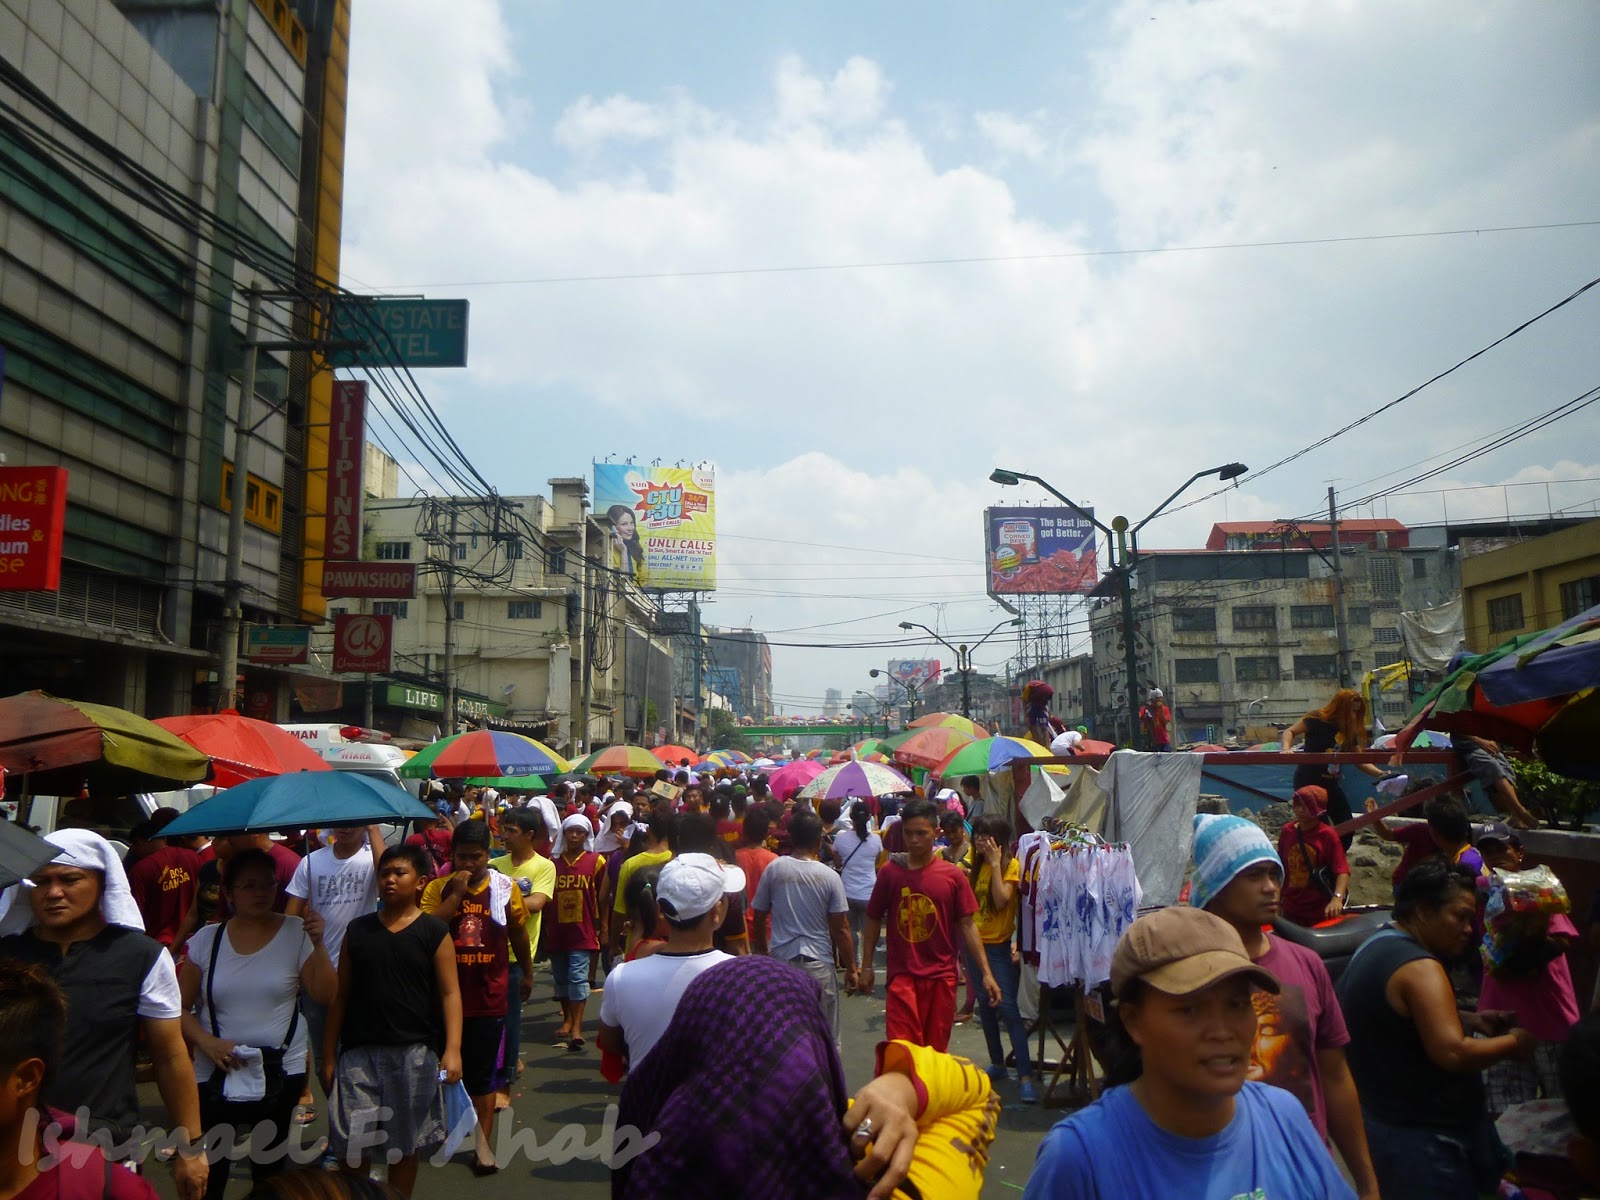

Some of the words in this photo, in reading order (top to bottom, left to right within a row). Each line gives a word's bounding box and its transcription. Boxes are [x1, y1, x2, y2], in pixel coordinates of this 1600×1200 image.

[332, 384, 353, 554] FILIPINAS
[1040, 518, 1054, 527] The
[1057, 518, 1075, 527] Best
[32, 529, 44, 542] &
[1041, 529, 1054, 538] got
[1056, 529, 1084, 538] Better.
[648, 538, 676, 548] UNLI
[680, 540, 714, 550] CALLS
[324, 571, 411, 589] PAWNSHOP
[462, 899, 483, 914] San
